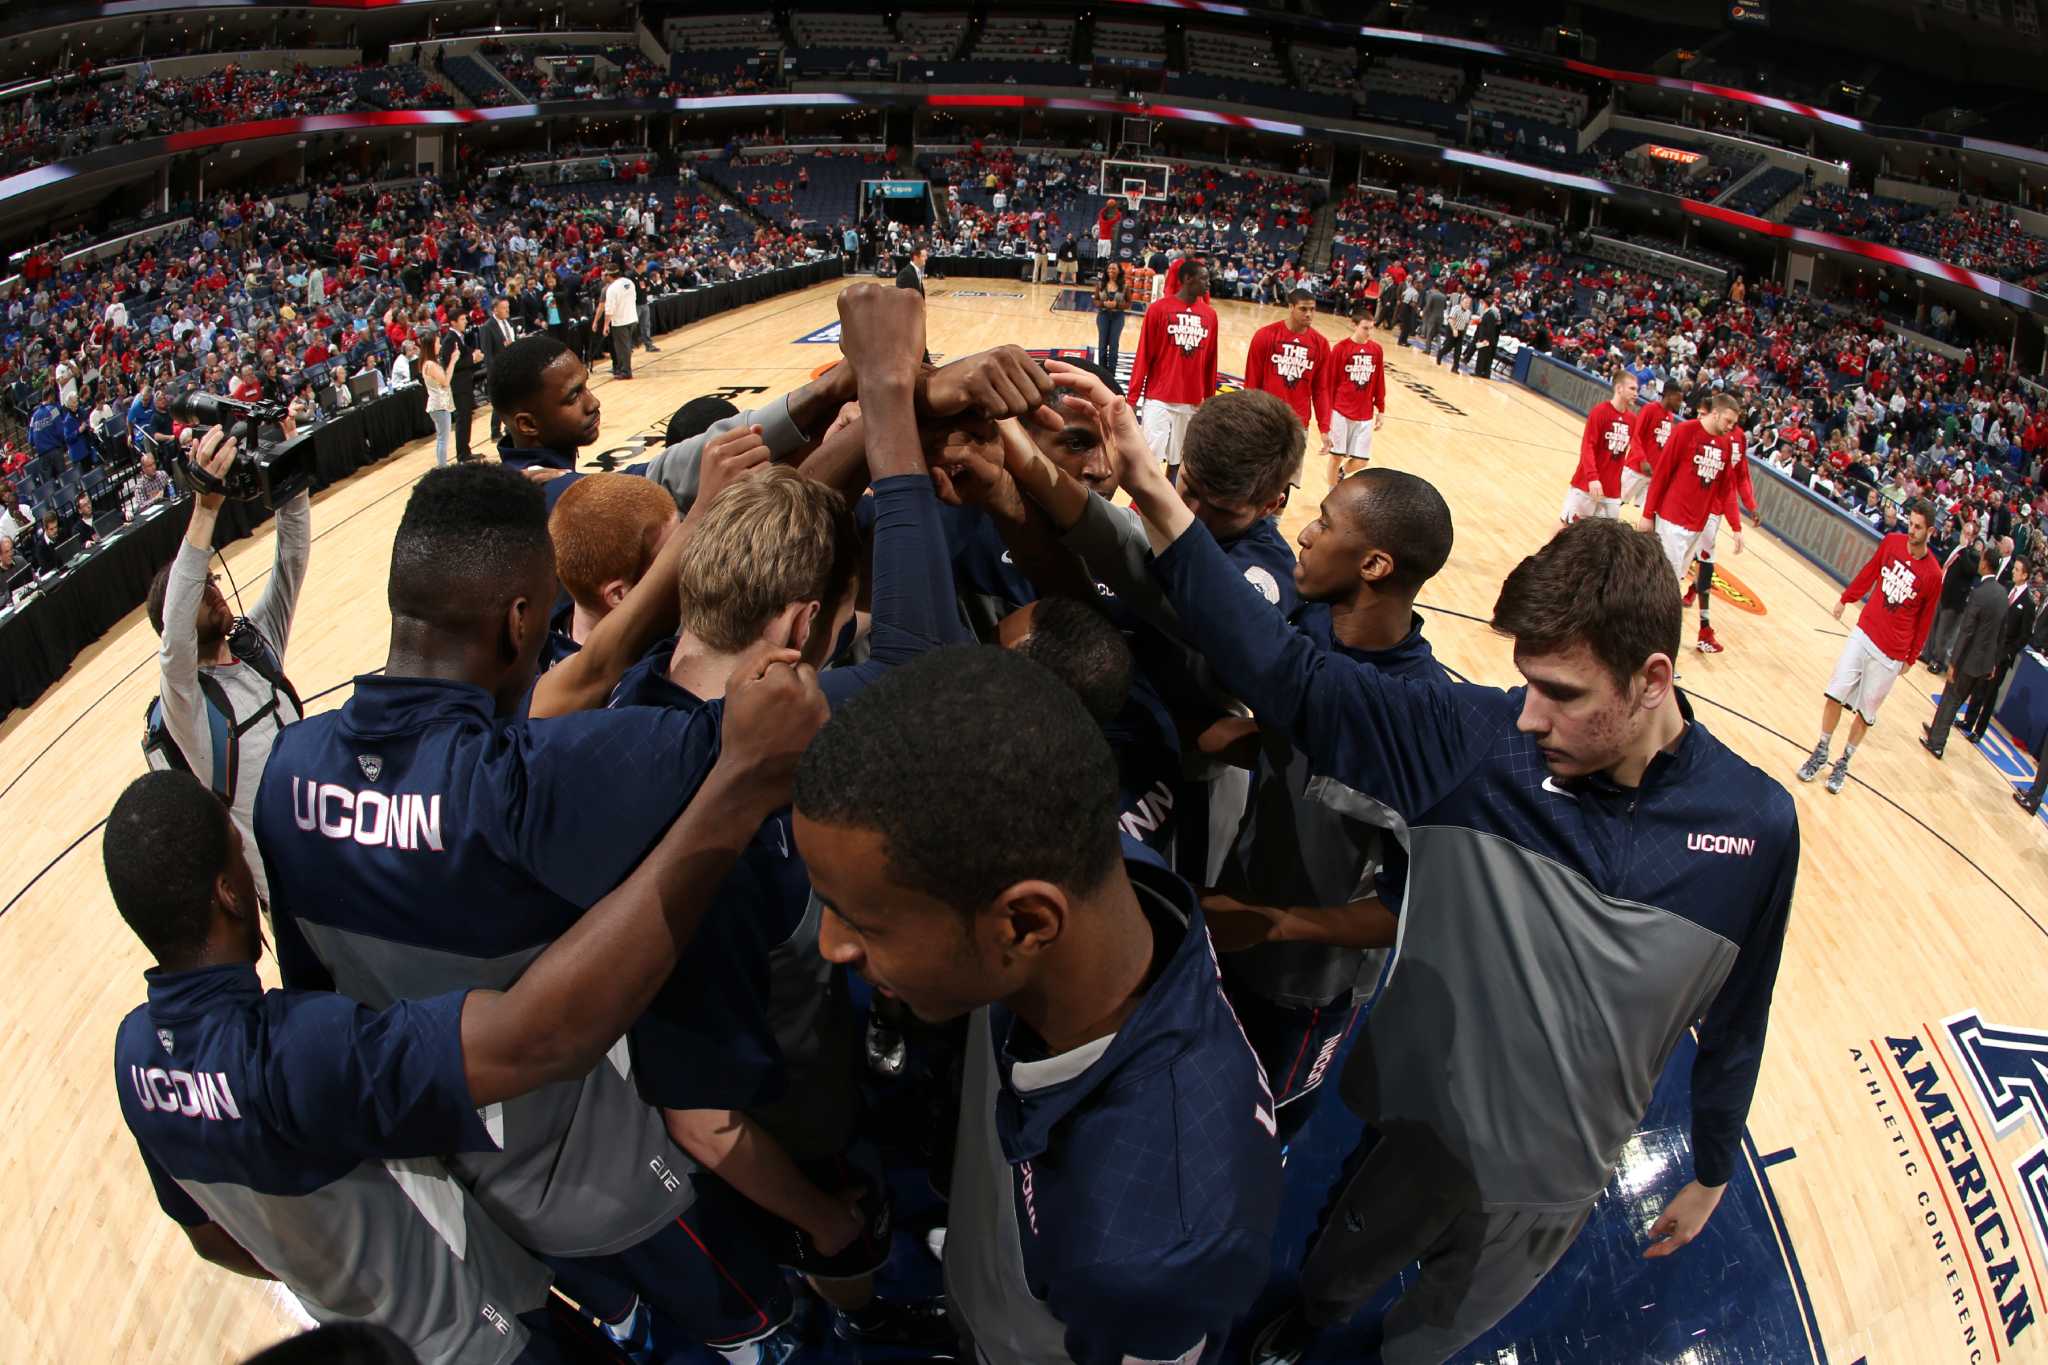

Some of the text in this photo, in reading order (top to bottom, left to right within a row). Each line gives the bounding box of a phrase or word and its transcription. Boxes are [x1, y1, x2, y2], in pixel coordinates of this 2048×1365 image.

[1176, 313, 1202, 327] THE
[1174, 333, 1202, 347] WAY
[1282, 343, 1308, 357] THE
[1352, 355, 1373, 366] THE
[1277, 362, 1305, 378] WAY
[1350, 371, 1371, 382] WAY
[1612, 422, 1629, 433] THE
[1704, 445, 1722, 460] THE
[1697, 464, 1719, 479] WAY
[1892, 560, 1916, 586] THE
[1882, 578, 1908, 603] WAY
[293, 775, 445, 851] UCONN
[1687, 832, 1755, 856] UCONN
[131, 1064, 242, 1120] UCONN
[1884, 1035, 2035, 1347] AMERICAN
[1849, 1048, 1982, 1365] ATHLETIC CONFERENC
